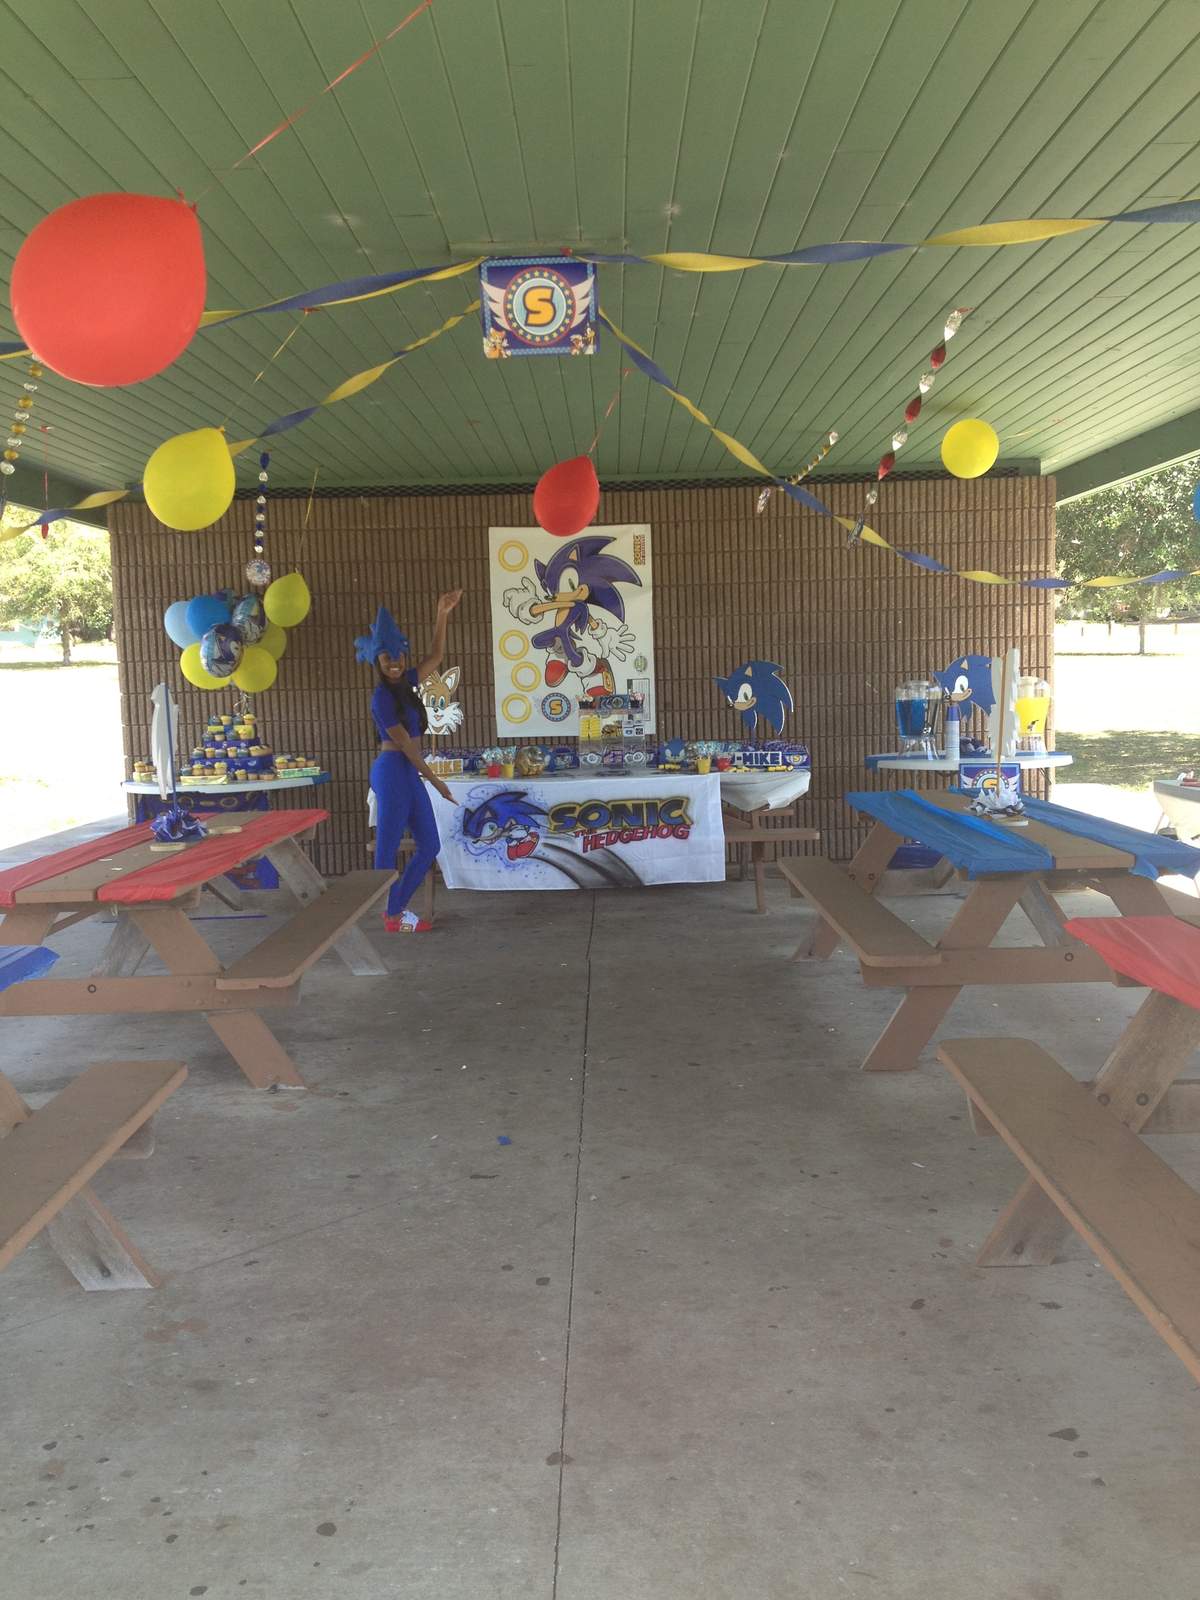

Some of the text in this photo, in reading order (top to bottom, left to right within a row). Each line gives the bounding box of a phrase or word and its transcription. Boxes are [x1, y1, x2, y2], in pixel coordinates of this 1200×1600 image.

[522, 285, 557, 328] S
[633, 534, 641, 566] SONIC
[549, 699, 563, 716] S
[742, 752, 781, 765] MIKE
[548, 796, 694, 834] SONIC
[582, 824, 691, 854] HEDGEHOG
